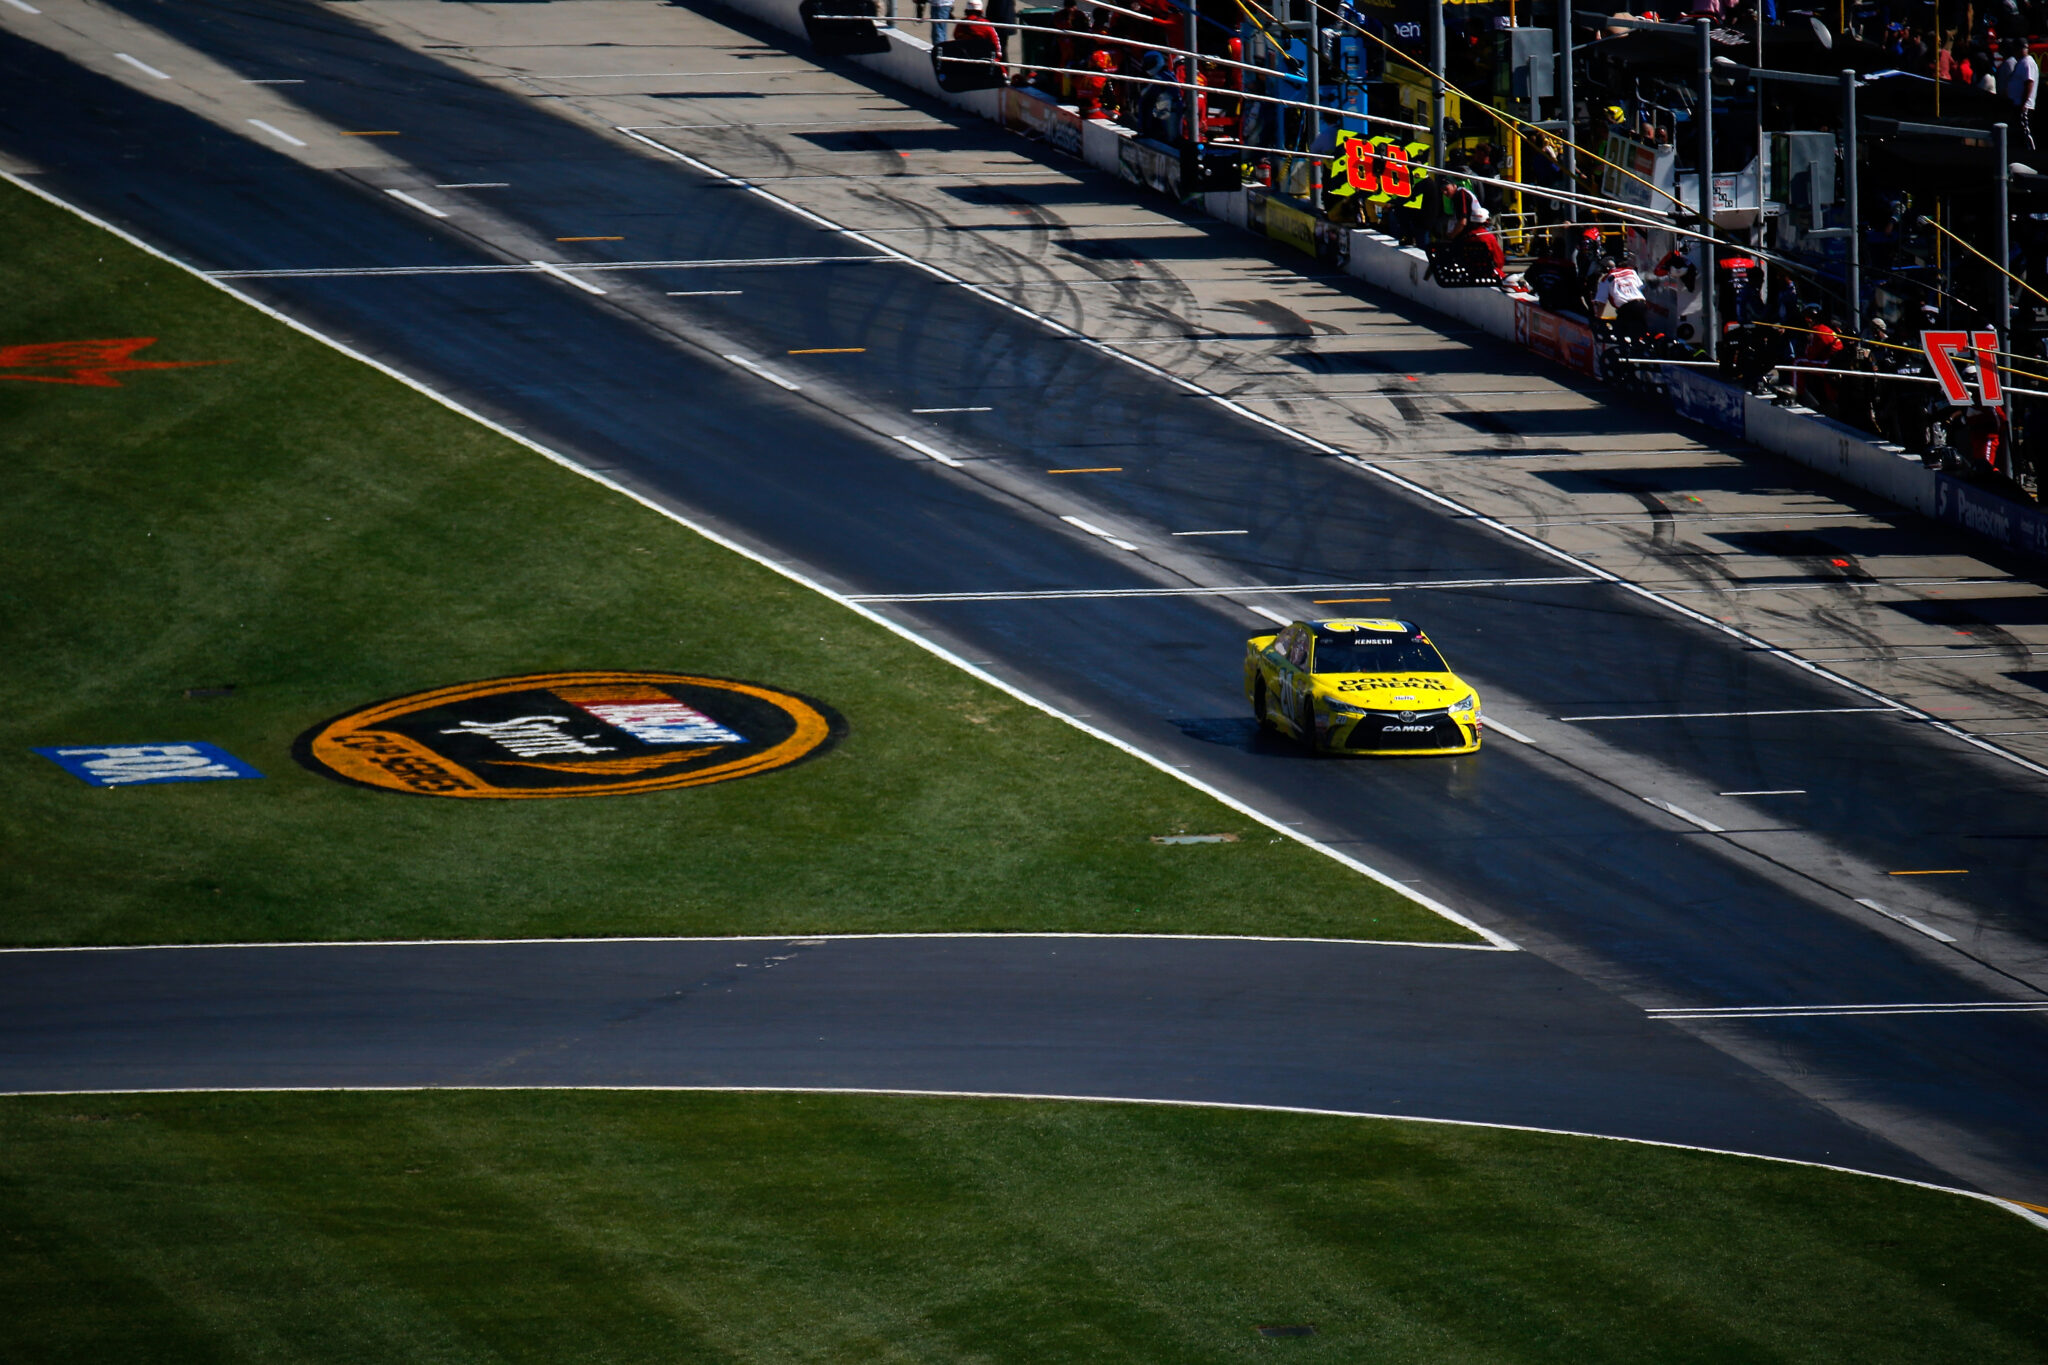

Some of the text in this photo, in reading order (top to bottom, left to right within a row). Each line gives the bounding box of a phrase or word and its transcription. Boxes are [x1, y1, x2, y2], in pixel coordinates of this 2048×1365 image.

[1344, 138, 1412, 198] 88
[1958, 487, 2010, 545] Panasonic
[1338, 682, 1455, 692] GENERAL
[1340, 676, 1442, 686] DOLLAR
[440, 715, 618, 758] Sprint
[56, 745, 240, 784] FOX
